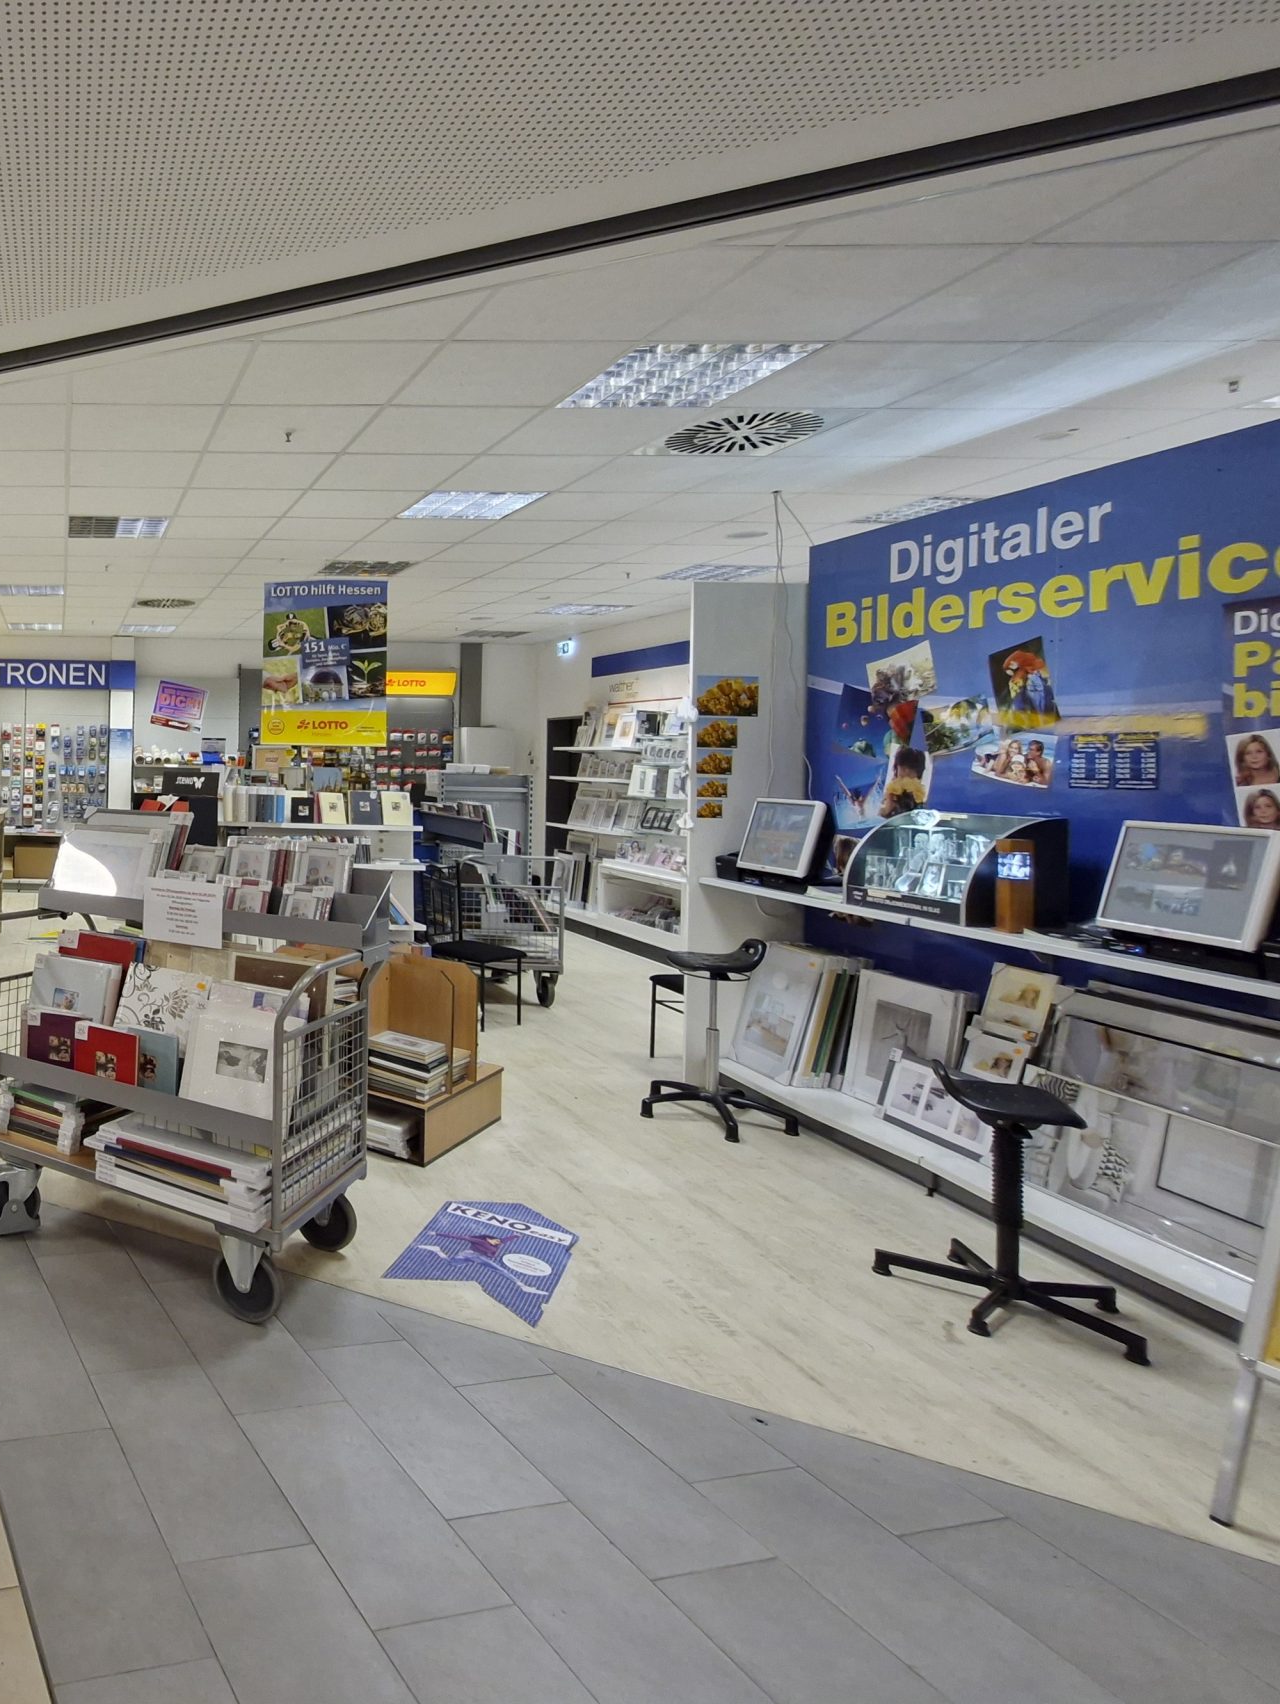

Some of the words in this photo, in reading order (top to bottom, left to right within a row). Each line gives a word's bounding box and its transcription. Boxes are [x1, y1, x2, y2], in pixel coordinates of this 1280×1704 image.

[890, 501, 1112, 585] Digitaler
[271, 585, 308, 597] LOTTO
[310, 584, 335, 596] hilft
[338, 584, 381, 595] Hessen
[303, 641, 325, 653] 151
[397, 679, 427, 687] LOTTO
[312, 720, 348, 730] LOTTO
[452, 1205, 531, 1231] KENO
